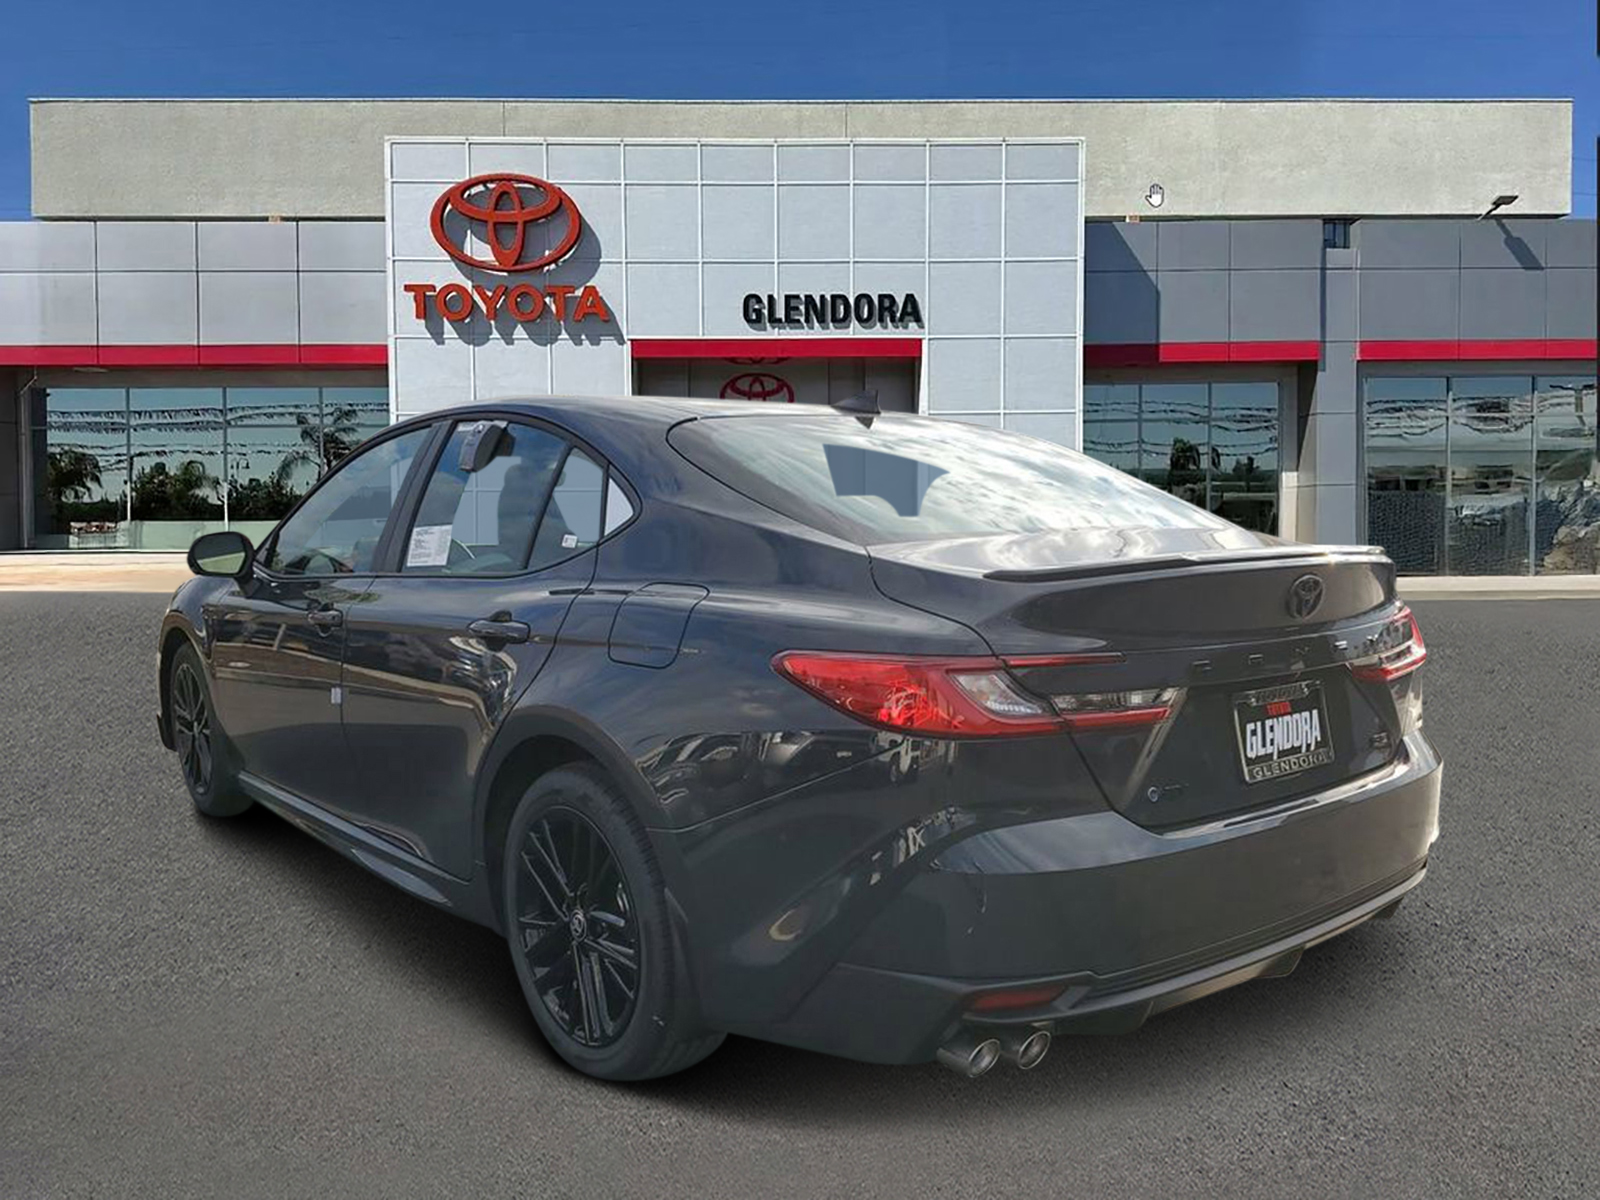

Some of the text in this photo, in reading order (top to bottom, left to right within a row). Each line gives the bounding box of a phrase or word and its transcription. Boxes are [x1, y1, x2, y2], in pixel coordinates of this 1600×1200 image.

[404, 284, 609, 322] TOYOTA
[743, 293, 922, 325] GLENDORA
[1246, 709, 1321, 760] GLENDORA
